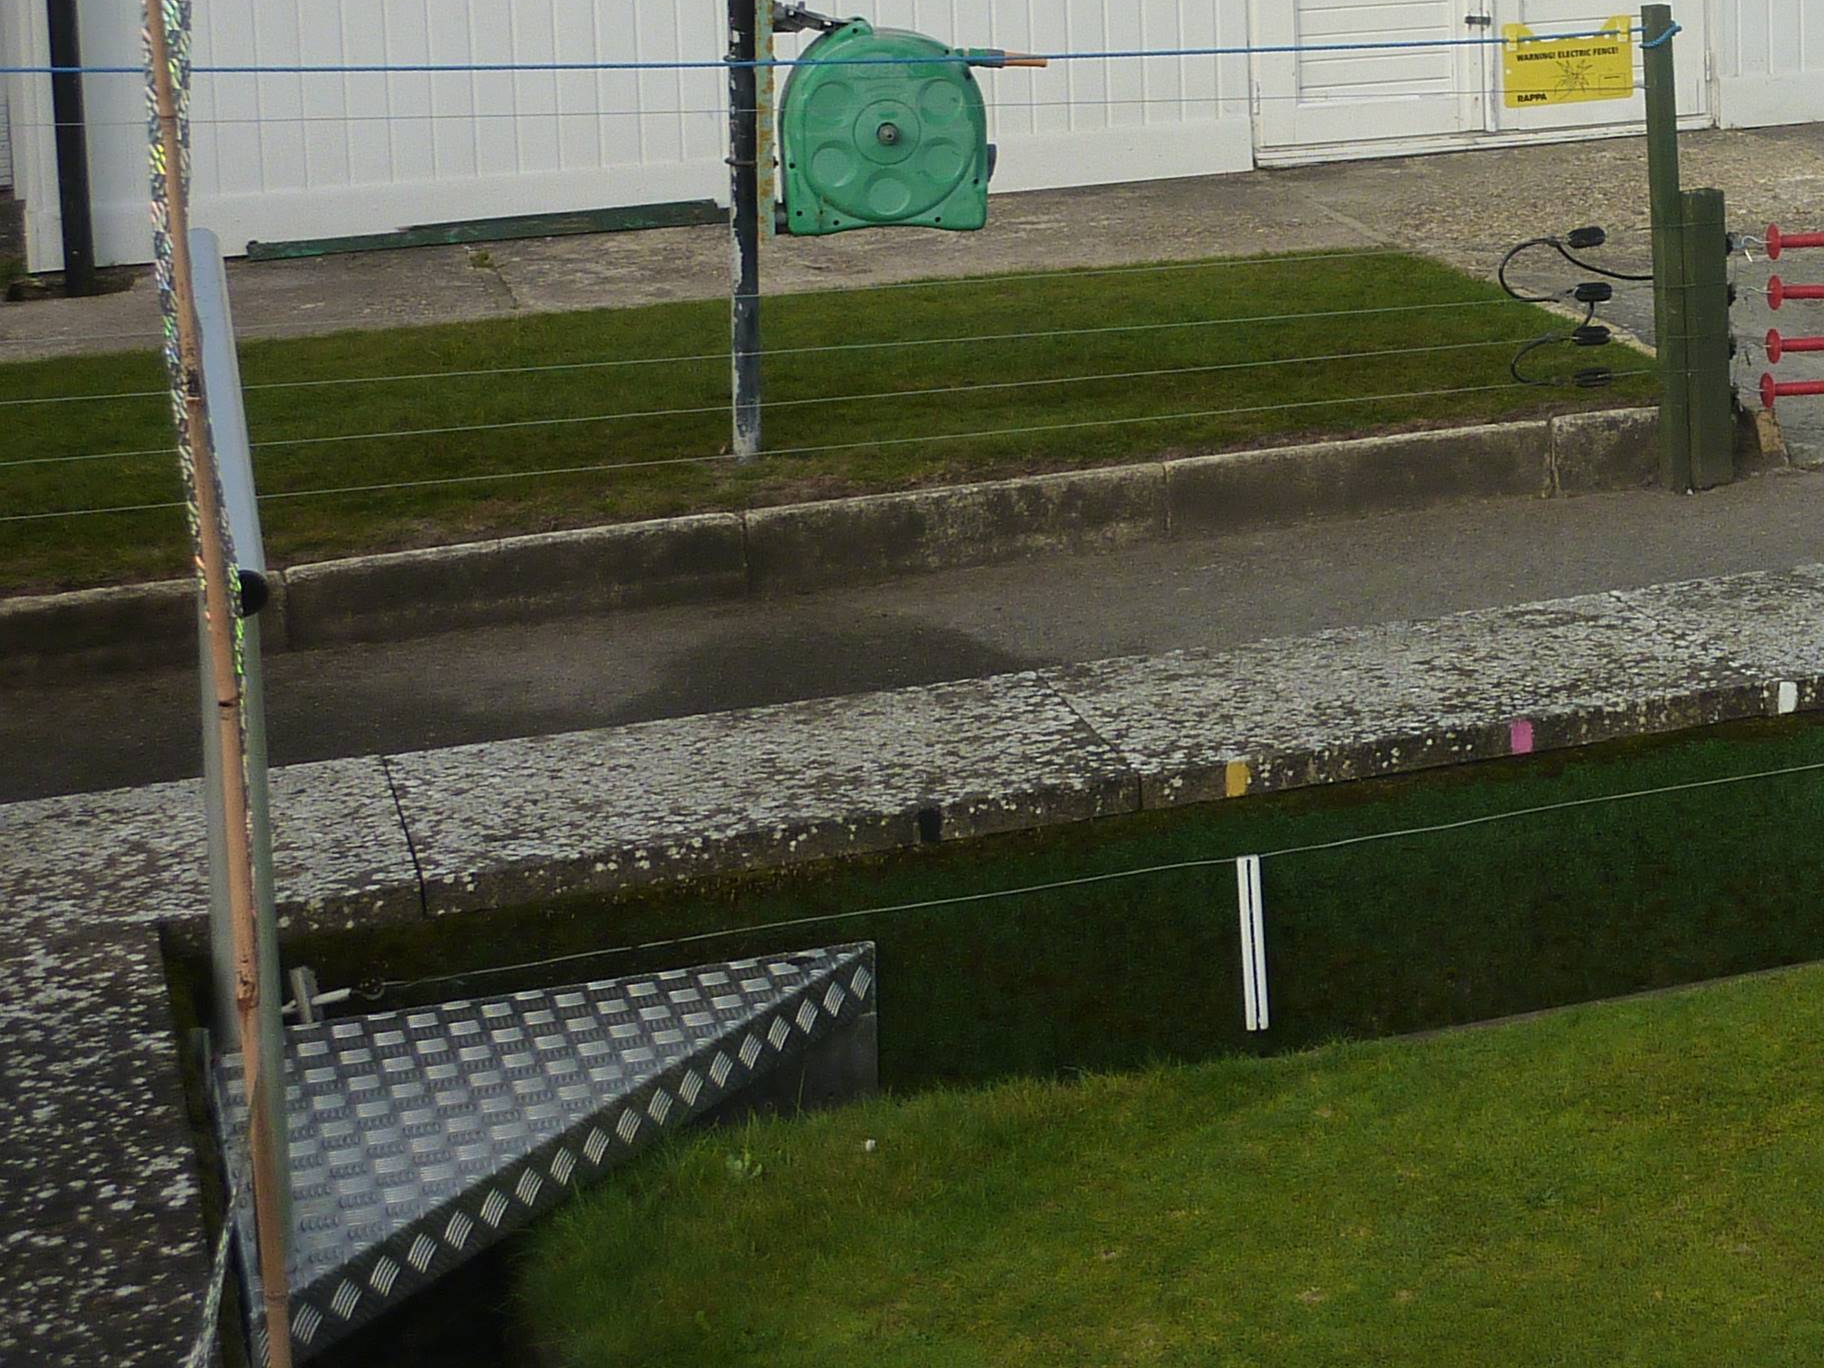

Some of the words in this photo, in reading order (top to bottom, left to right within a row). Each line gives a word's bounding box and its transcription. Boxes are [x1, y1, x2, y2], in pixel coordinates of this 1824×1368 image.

[1517, 51, 1556, 62] WARNING!
[1558, 48, 1591, 58] ELECTRIC
[1593, 46, 1618, 56] FENCE!
[1517, 93, 1547, 103] RAPPA
